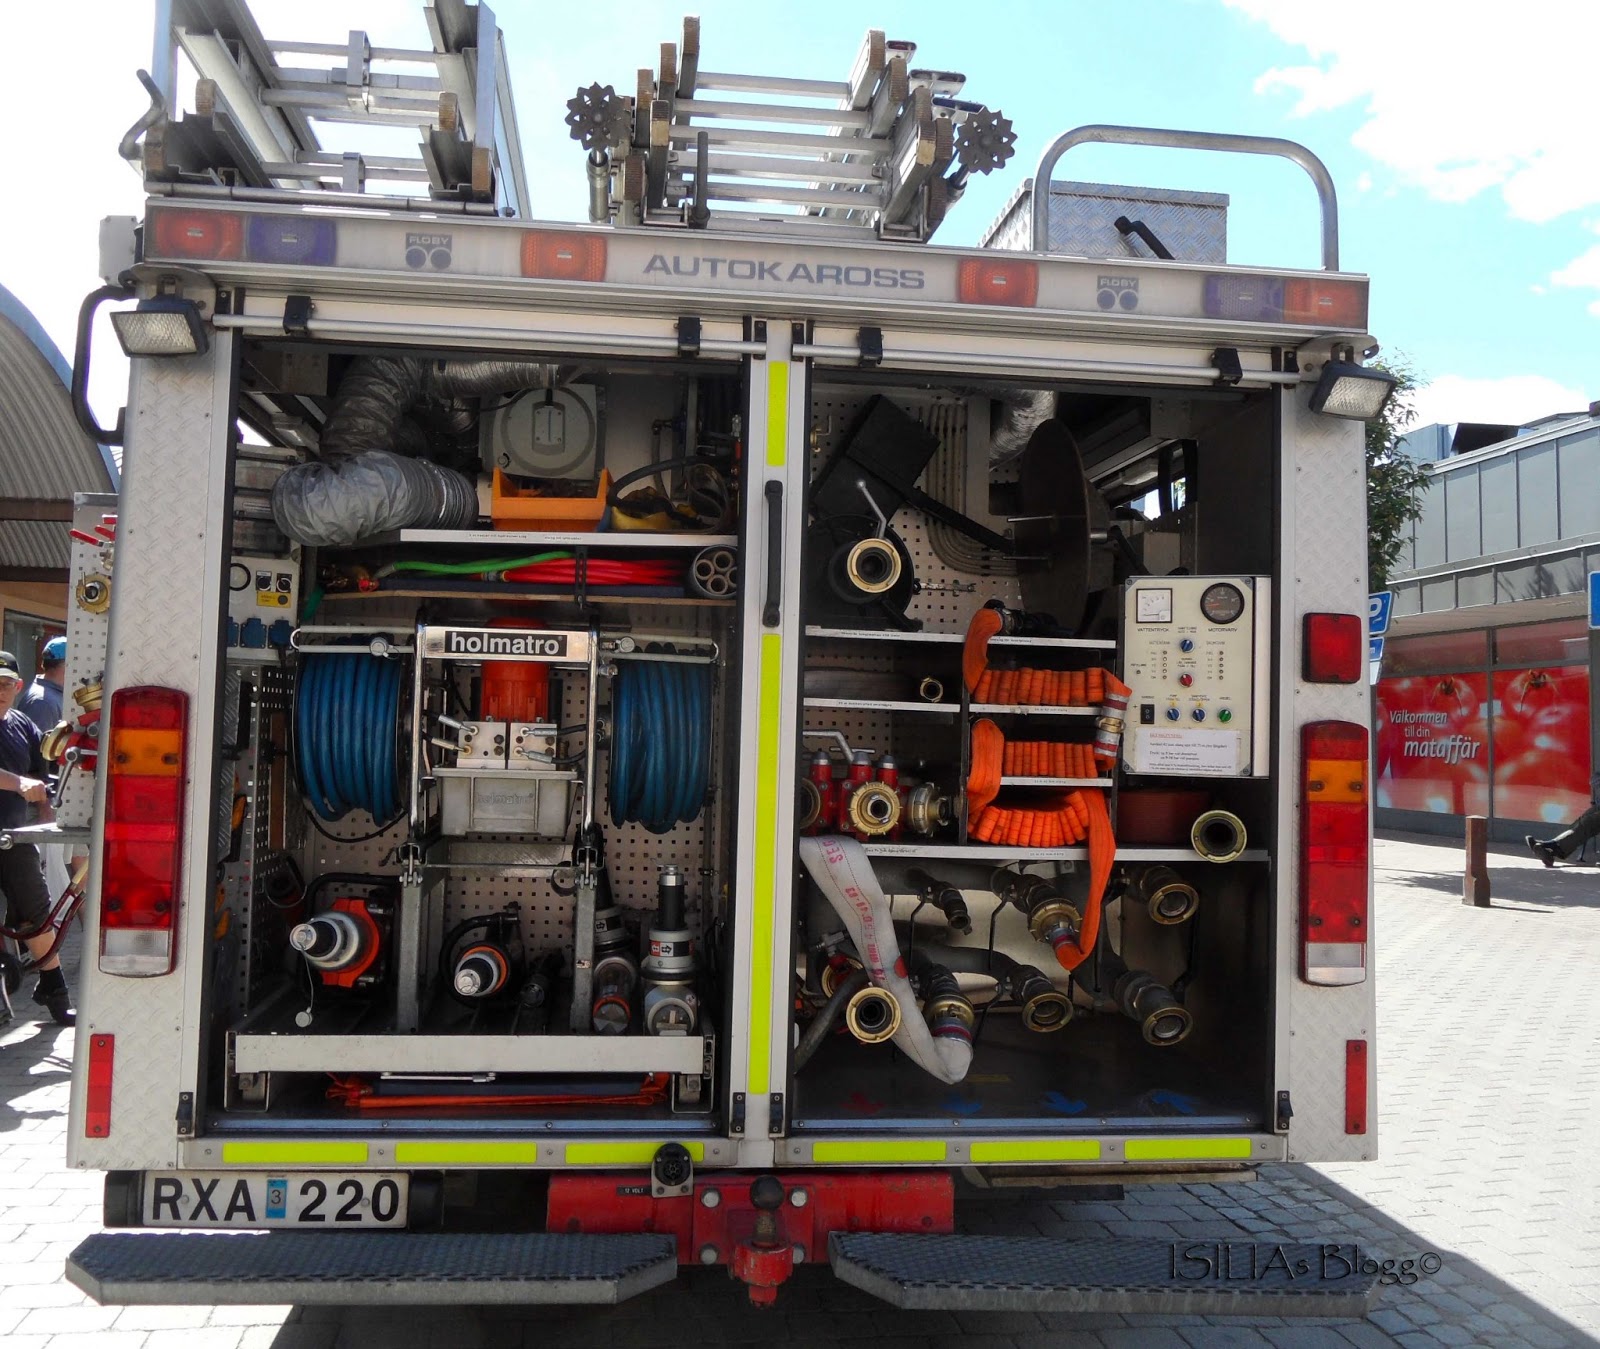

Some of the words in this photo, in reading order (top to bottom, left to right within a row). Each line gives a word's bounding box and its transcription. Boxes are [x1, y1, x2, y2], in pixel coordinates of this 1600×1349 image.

[642, 254, 925, 290] AUTOKAROSS
[451, 631, 560, 656] holmatro
[1390, 710, 1448, 725] Välkommen
[1404, 725, 1415, 738] till
[1416, 725, 1430, 738] din
[1404, 734, 1480, 765] mataffär
[152, 1177, 257, 1222] RXA
[298, 1179, 400, 1223] 220
[270, 1189, 282, 1205] 3
